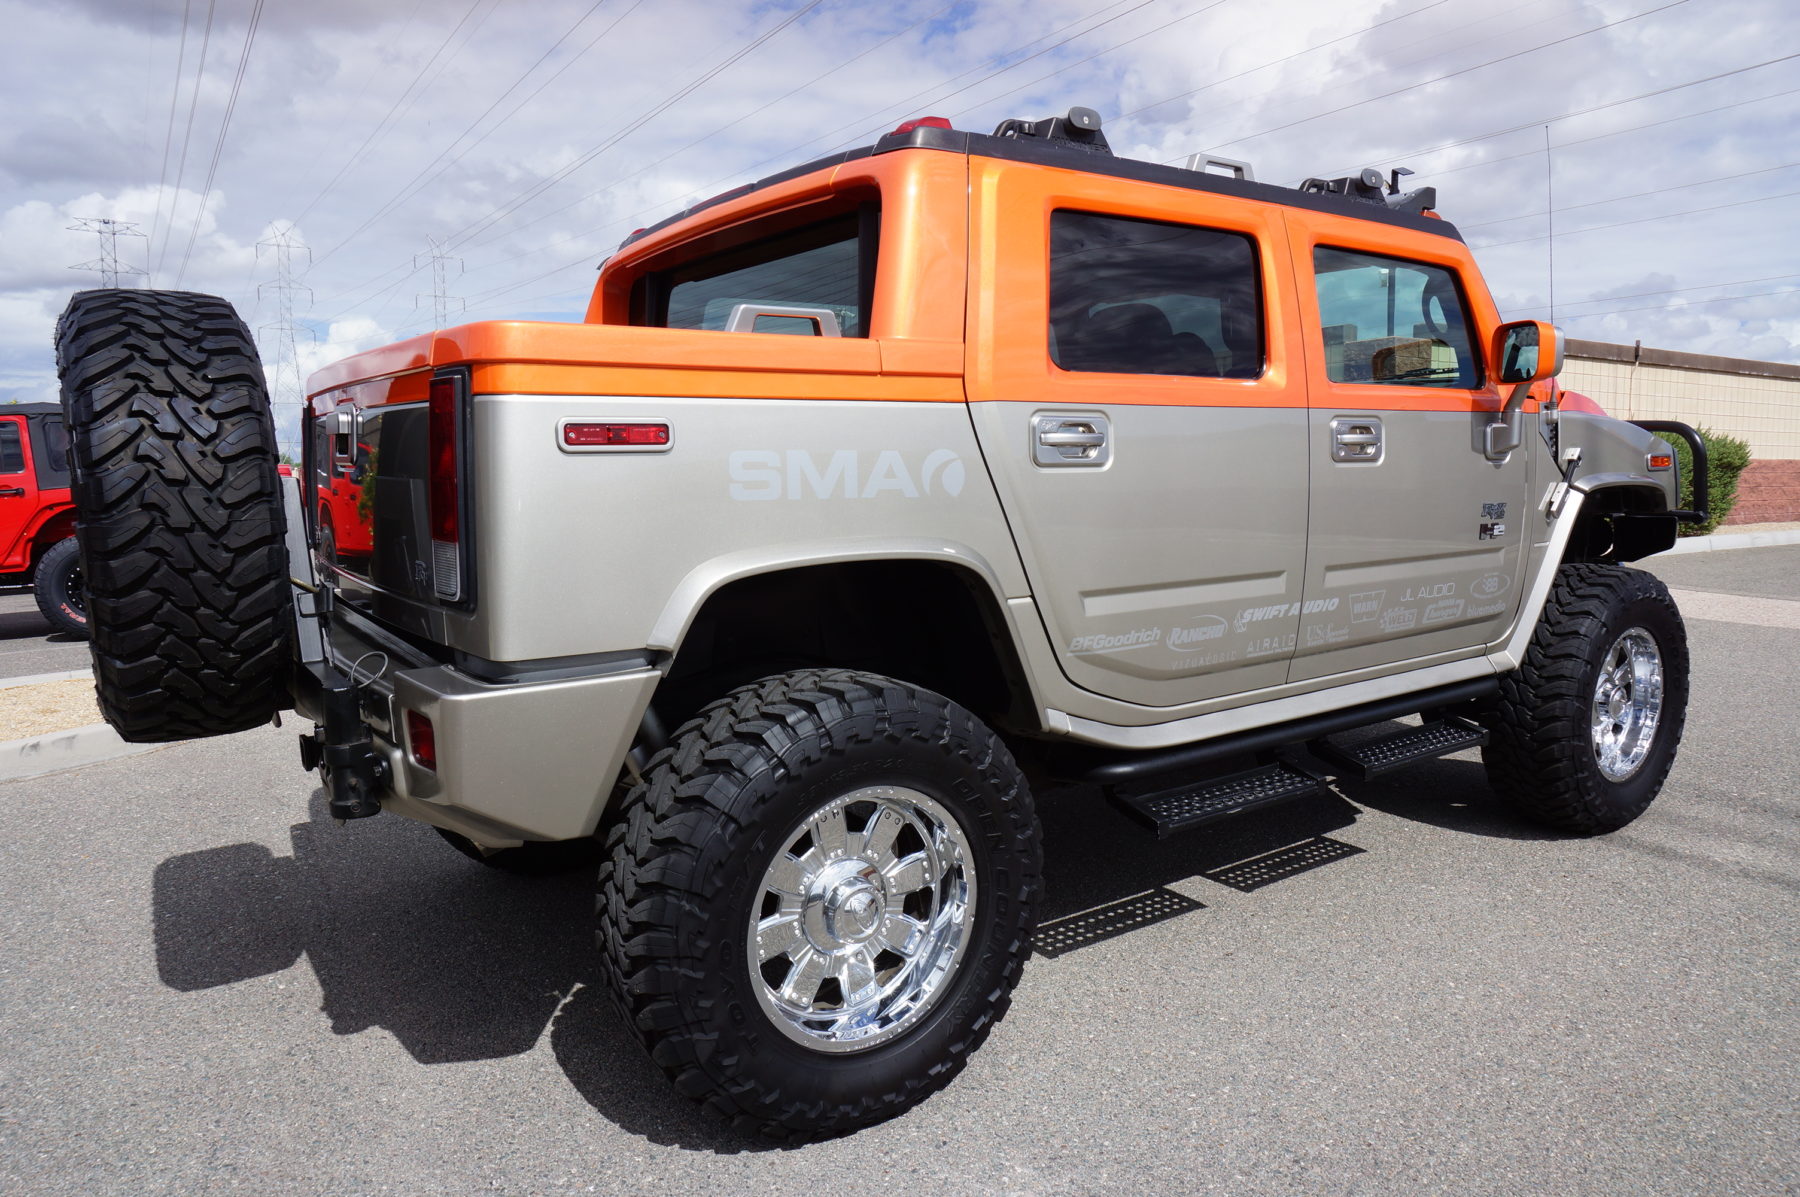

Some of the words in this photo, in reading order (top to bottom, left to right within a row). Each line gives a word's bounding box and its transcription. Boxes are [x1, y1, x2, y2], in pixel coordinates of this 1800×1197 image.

[728, 449, 921, 501] SMA
[1479, 522, 1505, 540] H2
[1417, 582, 1456, 598] AUDIO
[1241, 603, 1290, 622] SWIFT
[1287, 597, 1340, 617] AUDIO
[1070, 627, 1161, 650] BFGoodrich
[1168, 623, 1226, 646] RANCHO
[1246, 633, 1297, 653] AIRAID
